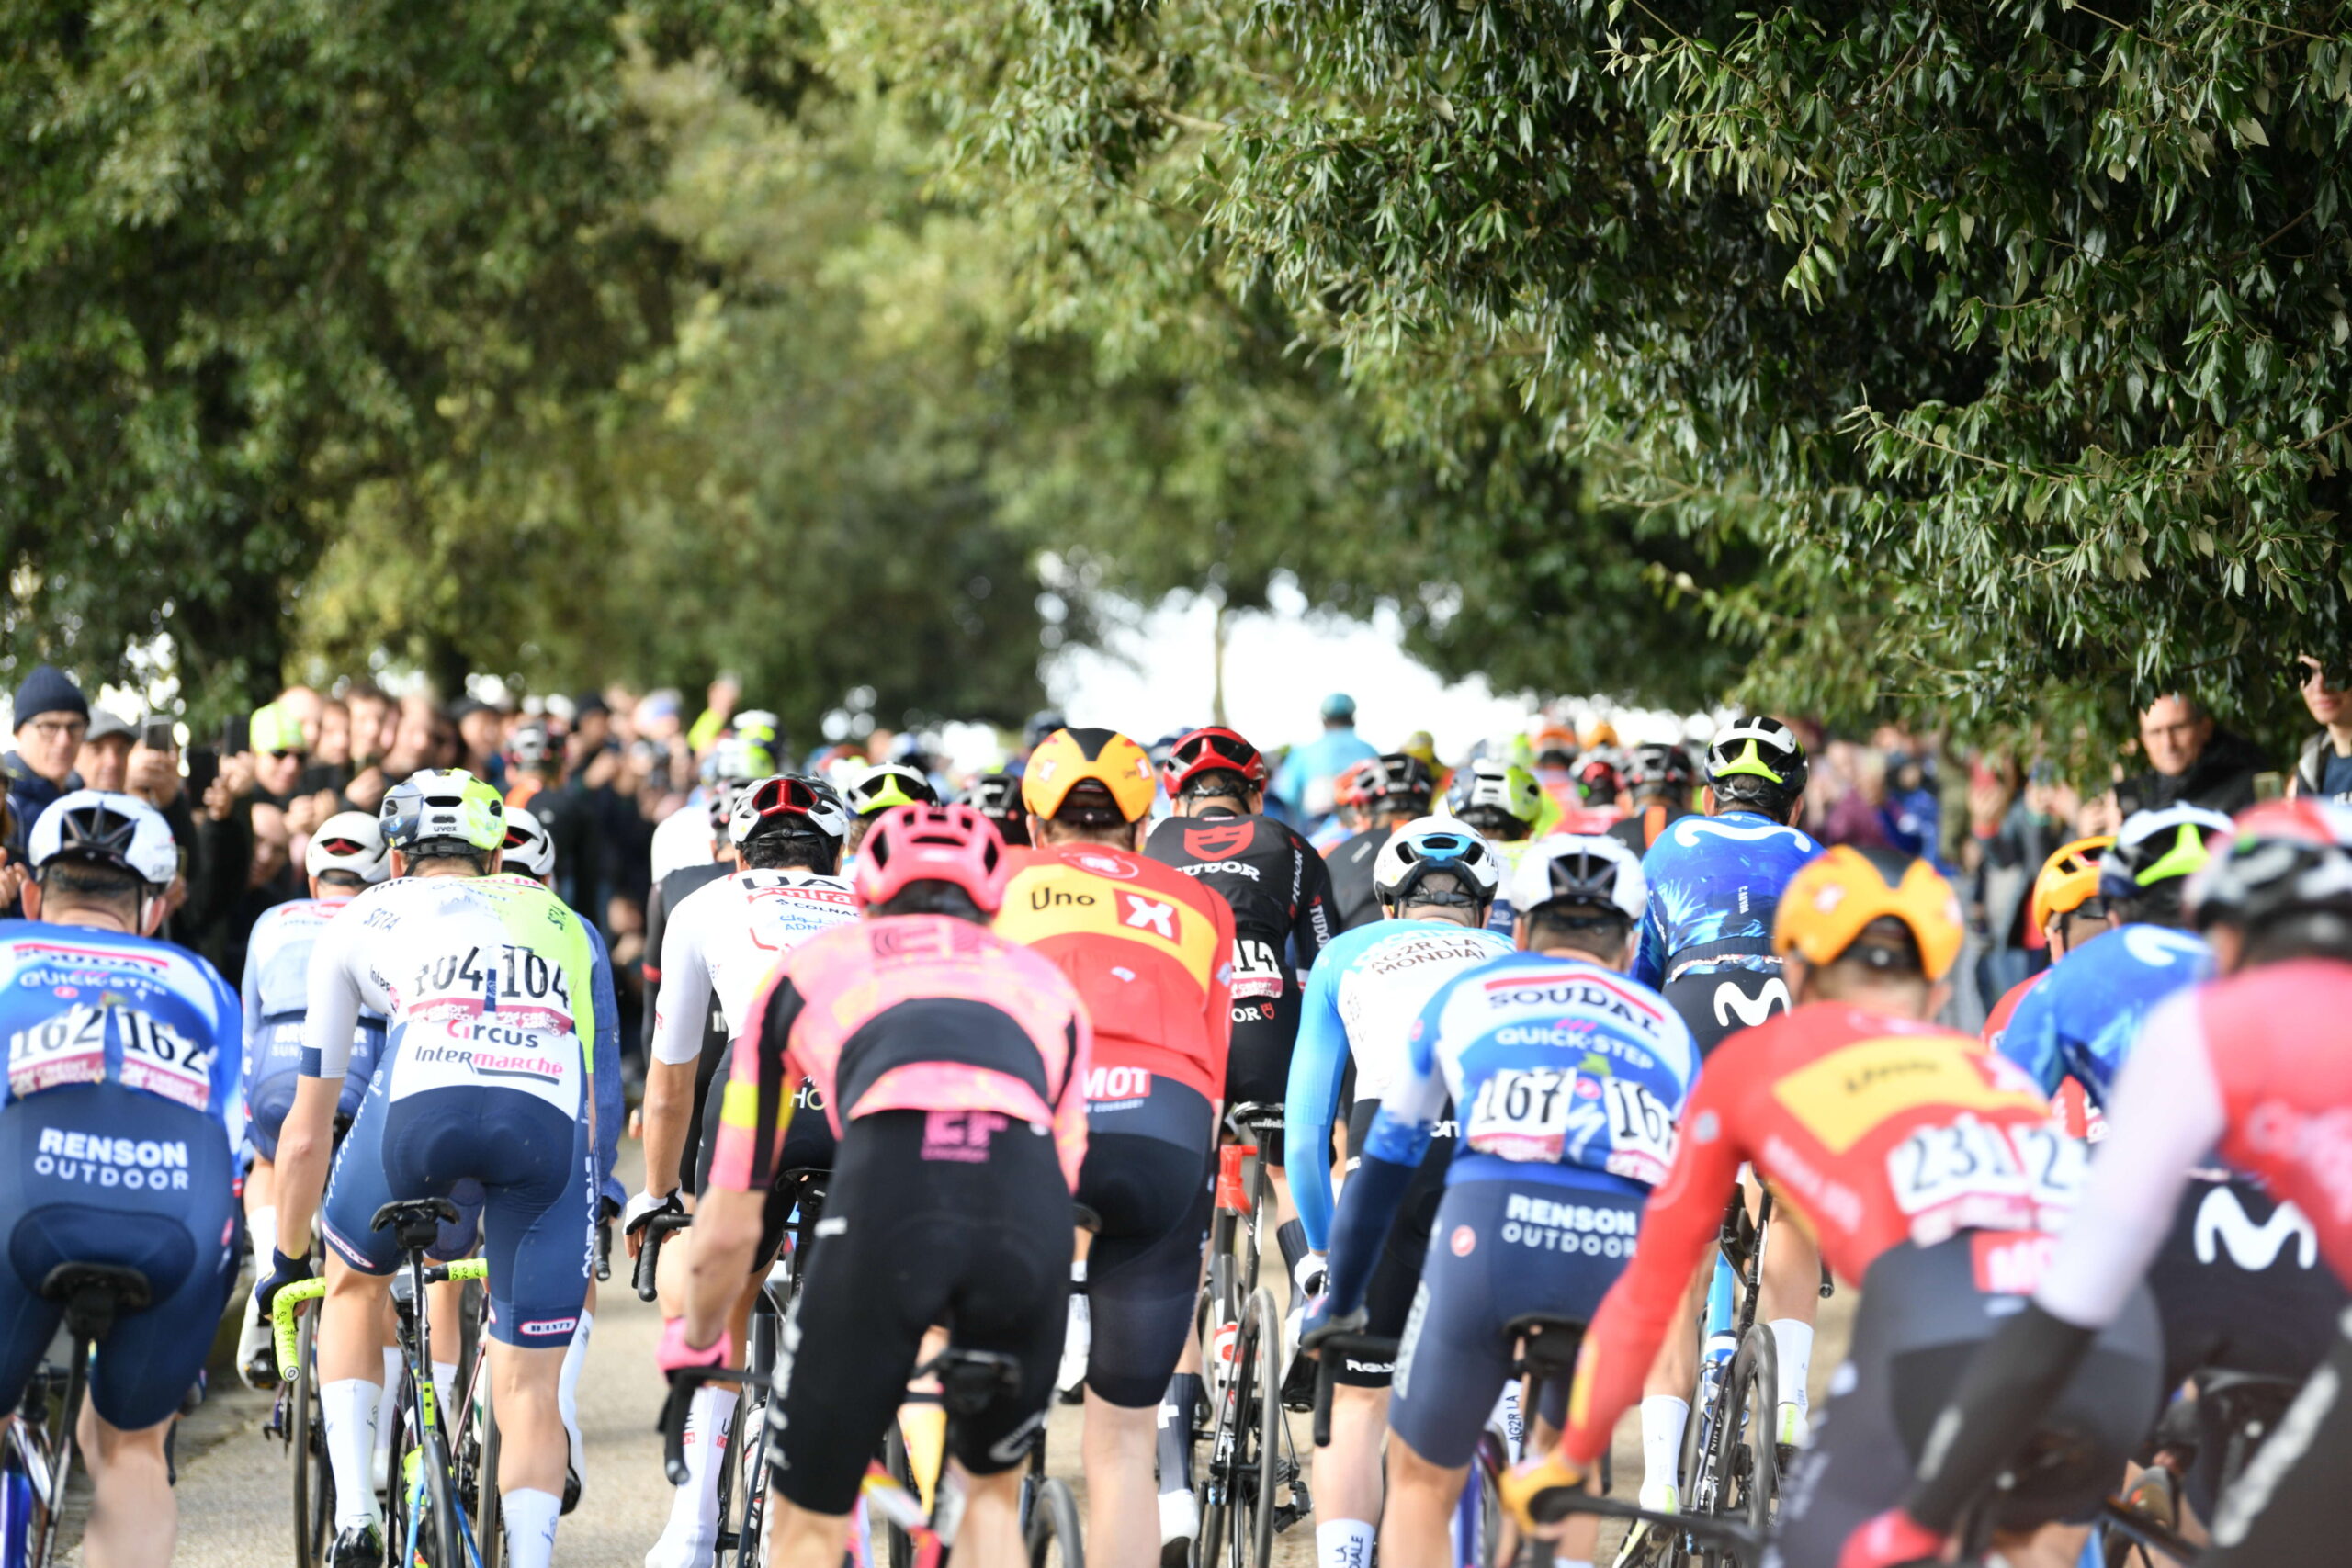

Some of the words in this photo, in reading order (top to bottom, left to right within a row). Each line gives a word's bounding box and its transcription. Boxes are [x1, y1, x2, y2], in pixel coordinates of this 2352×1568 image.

[433, 825, 458, 833] uvex
[741, 875, 849, 891] UA
[1175, 861, 1261, 882] UDOR
[1030, 886, 1096, 911] Uno
[1125, 894, 1174, 939] X
[1309, 905, 1331, 950] TUDO
[414, 946, 484, 997] 104
[501, 945, 569, 1009] 104
[1232, 940, 1274, 973] 14
[1371, 941, 1432, 970] AG2R
[19, 1010, 104, 1058] 162
[447, 1019, 539, 1049] Circus
[1489, 986, 1660, 1039] SOUDAL
[1480, 1071, 1566, 1124] 167
[1611, 1081, 1676, 1152] 16
[38, 1127, 188, 1168] RENSON
[34, 1155, 189, 1190] OUTDOOR
[1505, 1192, 1638, 1236] RENSON
